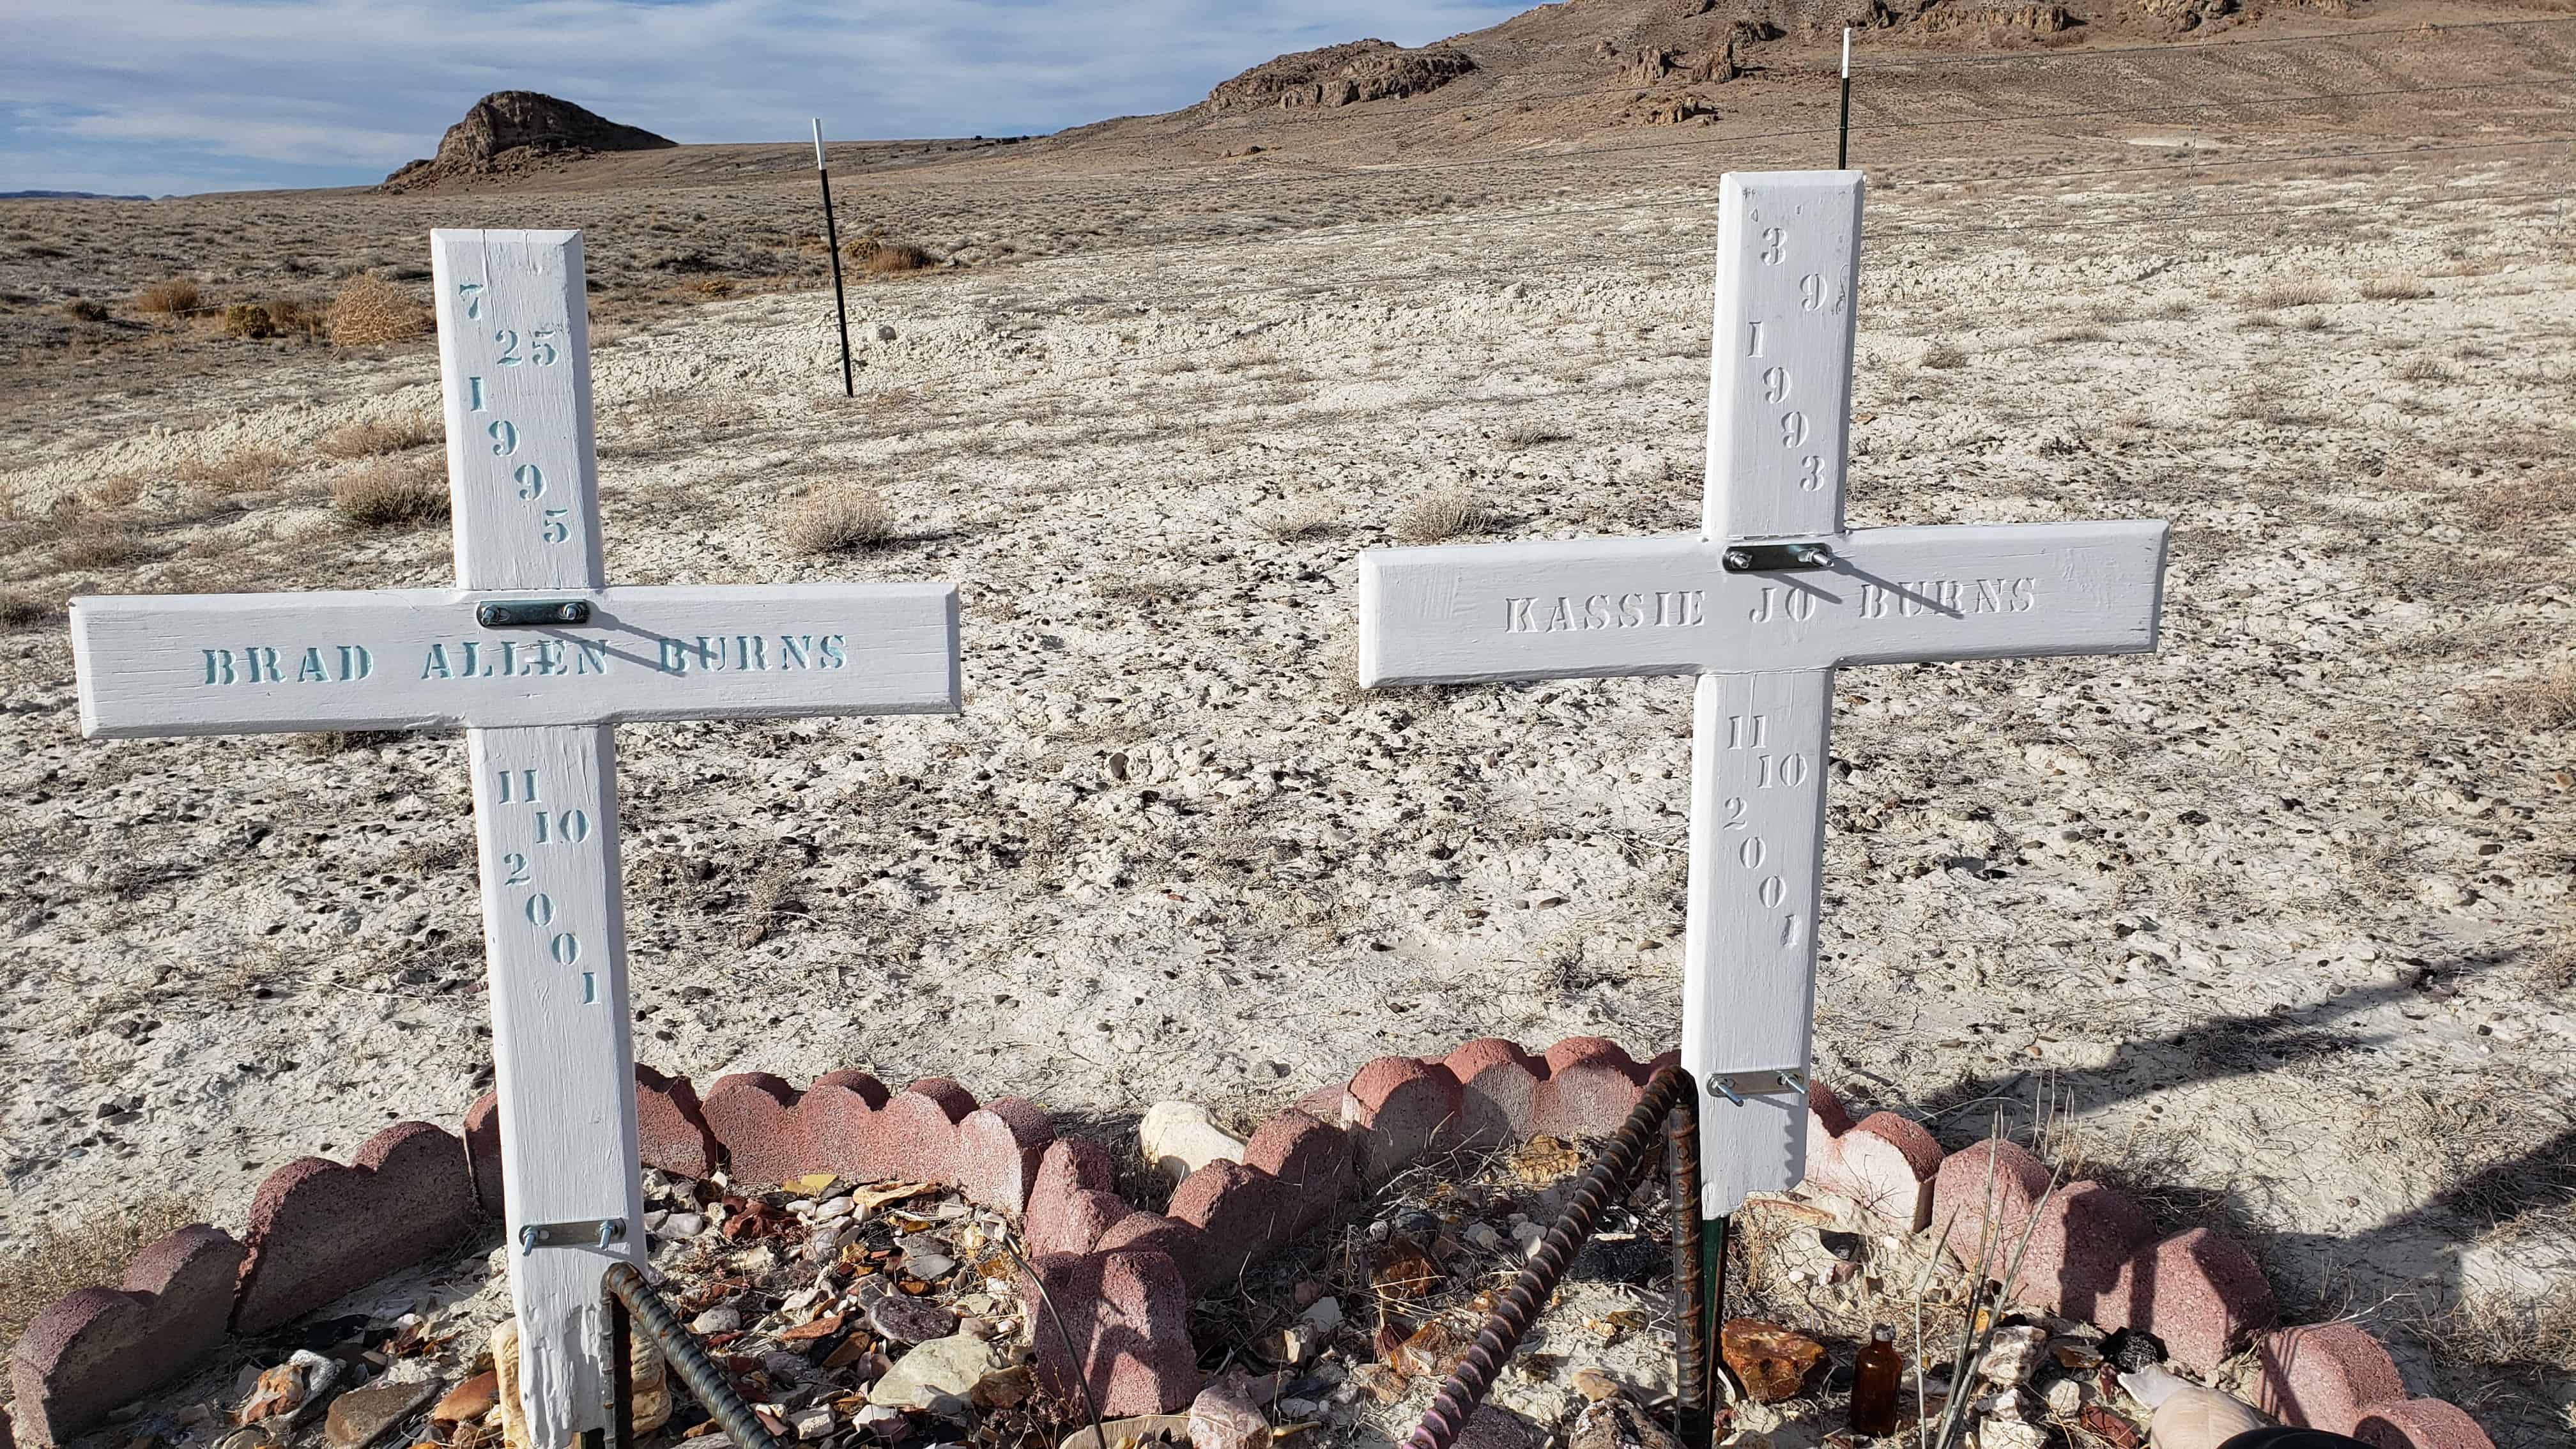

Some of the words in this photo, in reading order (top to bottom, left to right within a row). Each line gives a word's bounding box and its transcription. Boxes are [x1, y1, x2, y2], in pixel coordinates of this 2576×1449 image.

[1761, 227, 1788, 266] 3
[459, 283, 484, 321] 7
[1799, 273, 1828, 312] 9
[496, 329, 560, 367] 25
[1505, 590, 1705, 633] KASSIE
[1749, 587, 1816, 624] JO
[1859, 578, 2036, 618] BURNS
[202, 645, 373, 685] BRAD
[420, 640, 608, 680] ALLEN
[659, 634, 847, 672] BURNS
[1727, 715, 1767, 750] 11
[498, 769, 542, 805] 11
[1757, 753, 1808, 789] 10
[535, 809, 592, 845] 10
